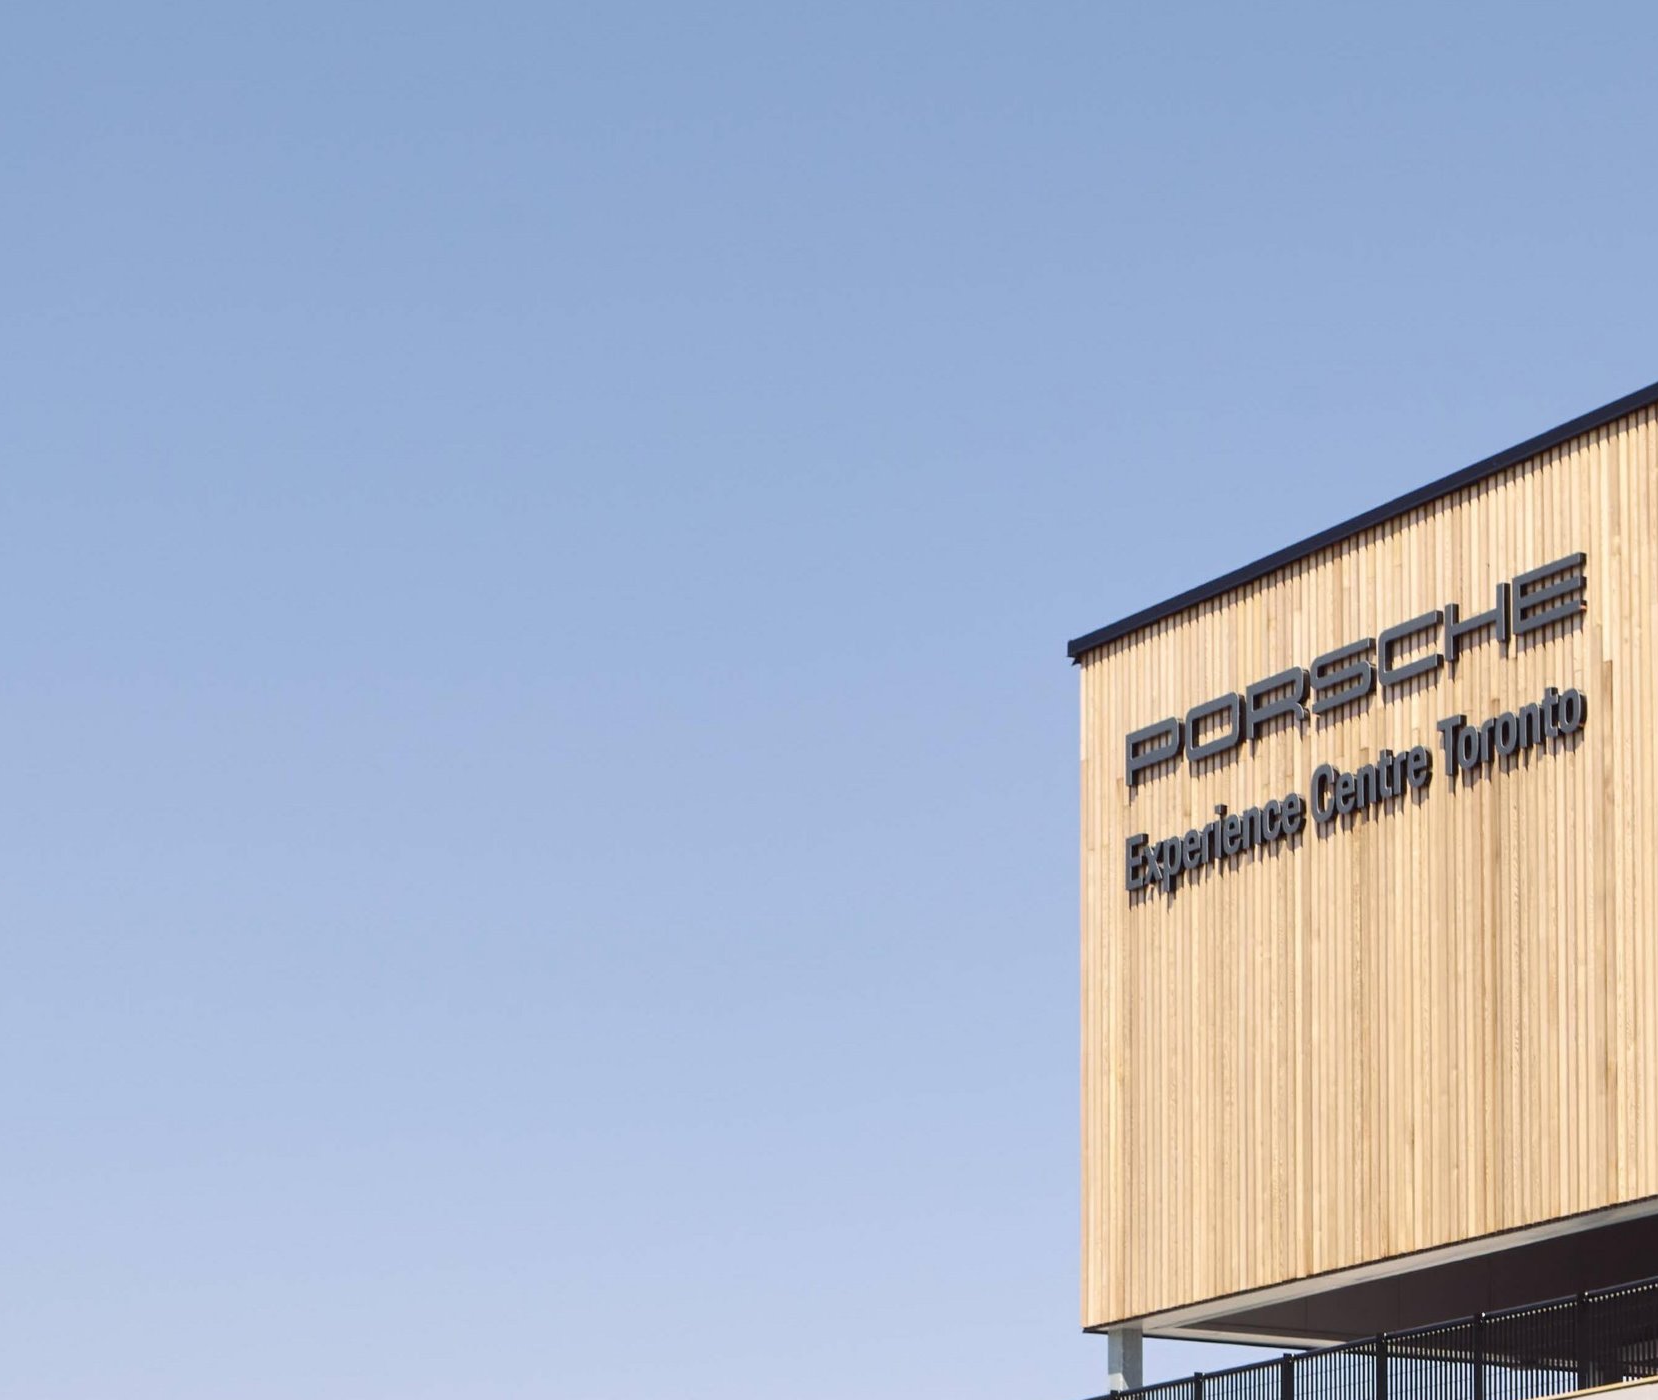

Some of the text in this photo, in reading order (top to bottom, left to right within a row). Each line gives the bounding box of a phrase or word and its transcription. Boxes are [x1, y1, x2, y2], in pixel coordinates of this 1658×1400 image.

[1125, 551, 1587, 787] PORSCHE
[1125, 686, 1588, 892] Experience Centre Toronto
